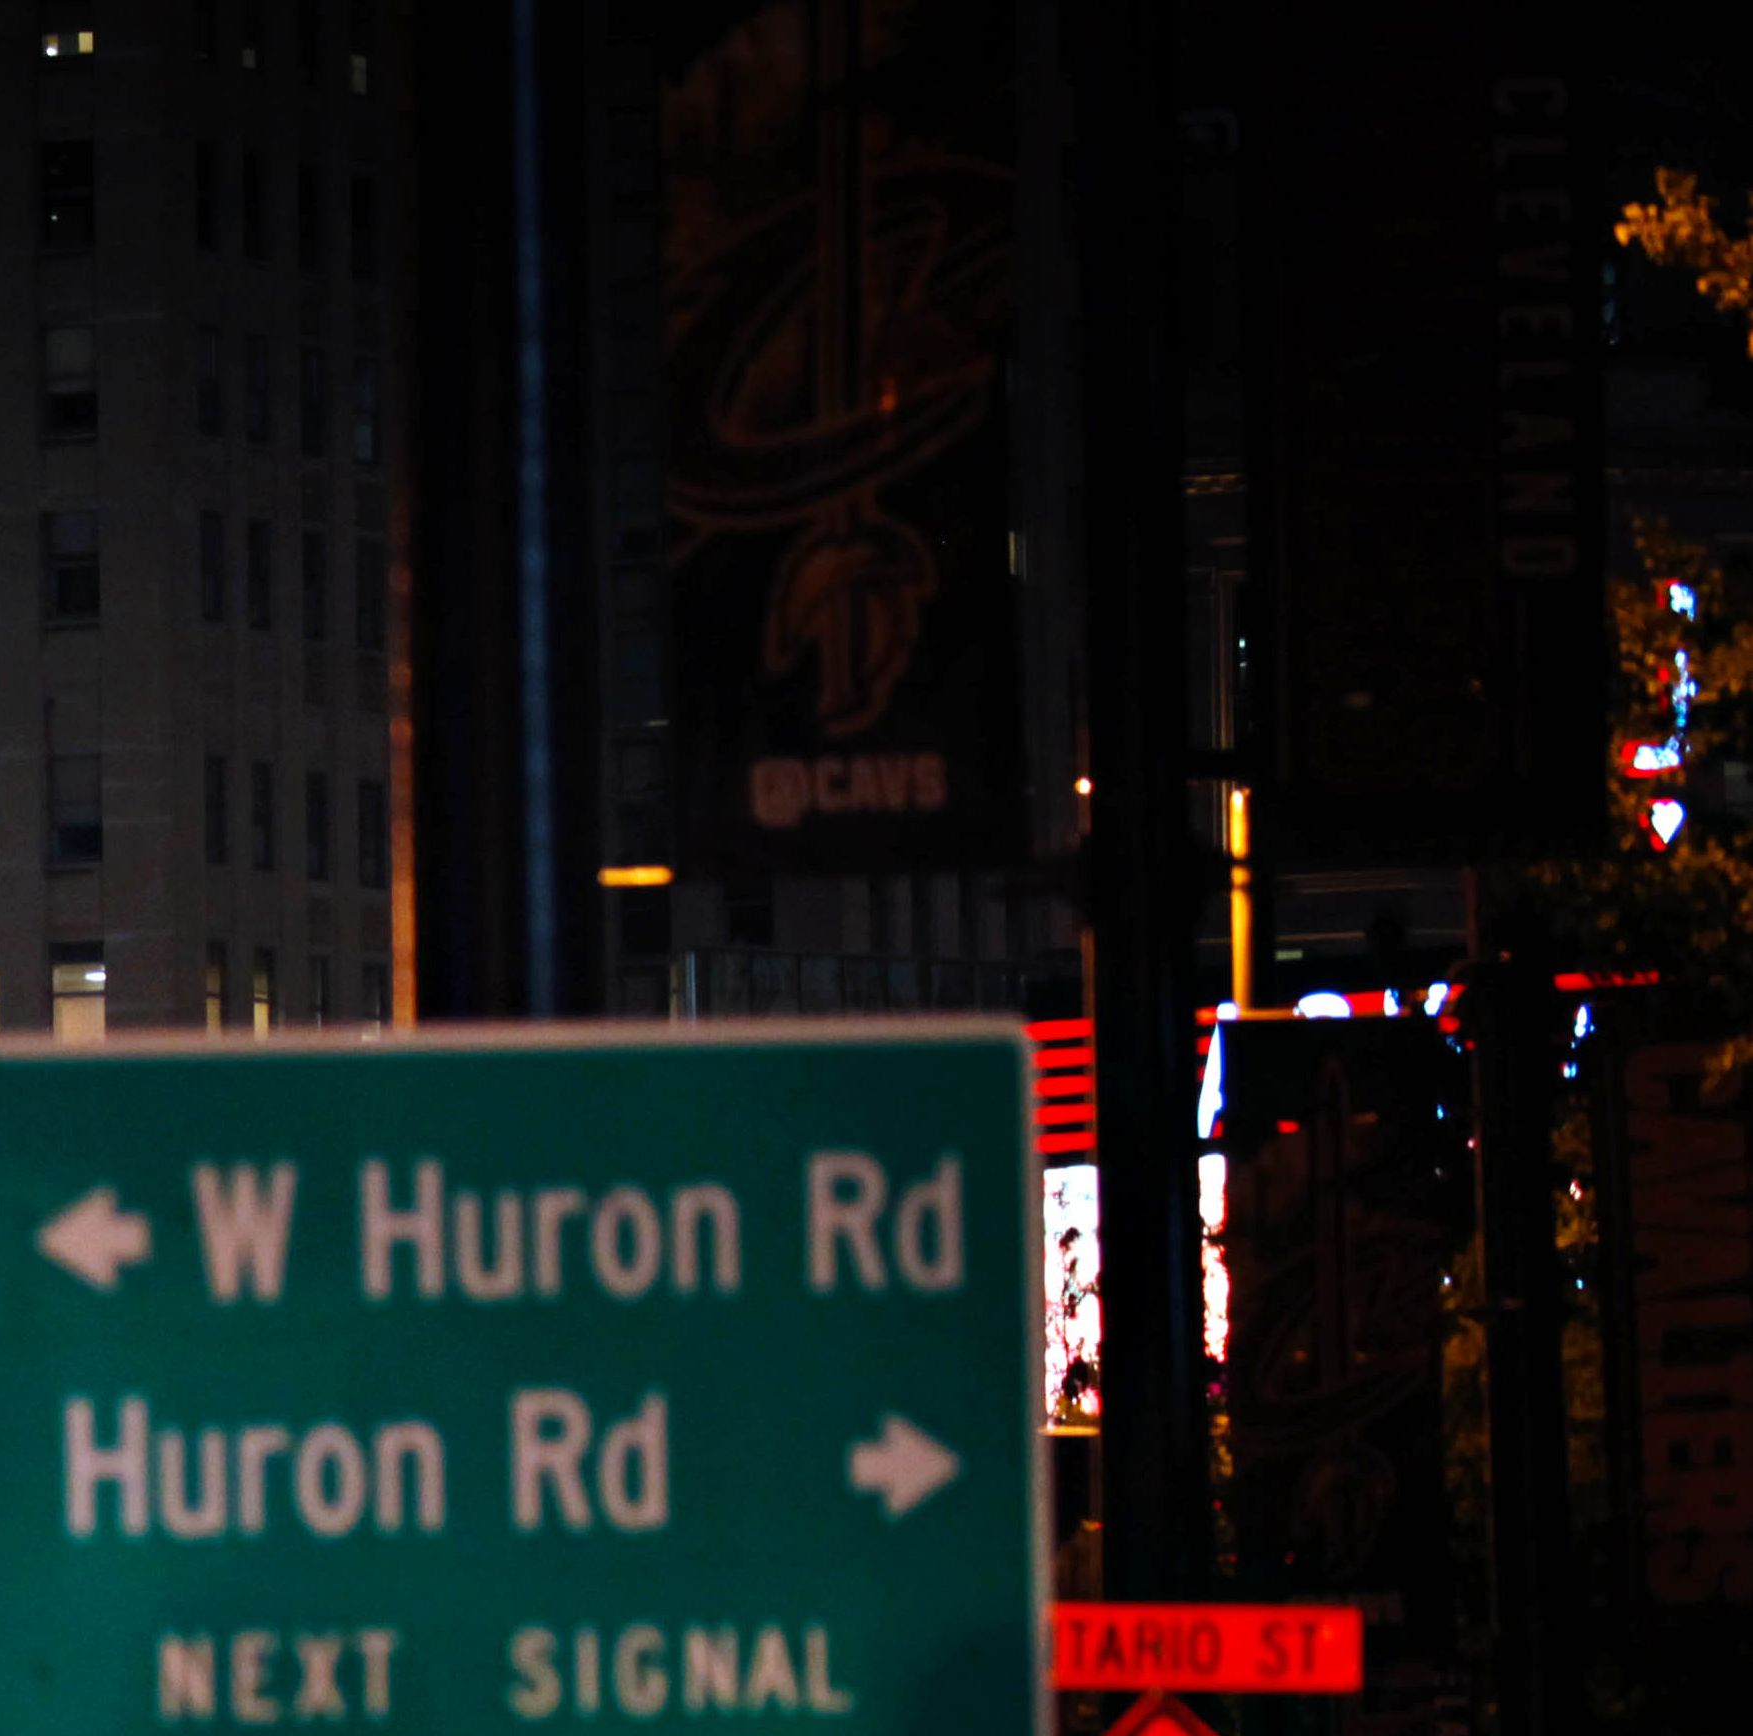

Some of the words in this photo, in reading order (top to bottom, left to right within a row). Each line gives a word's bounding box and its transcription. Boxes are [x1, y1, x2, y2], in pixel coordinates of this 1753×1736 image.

[192, 1163, 296, 1302] W
[359, 1158, 741, 1301] Huron
[806, 1151, 964, 1292] Rd
[63, 1396, 446, 1540] Huron
[510, 1388, 669, 1531] Rd
[157, 1629, 394, 1723] NEXT
[511, 1625, 850, 1718] SIGNAL
[1069, 1616, 1222, 1677] TARIO
[1257, 1617, 1321, 1679] ST
